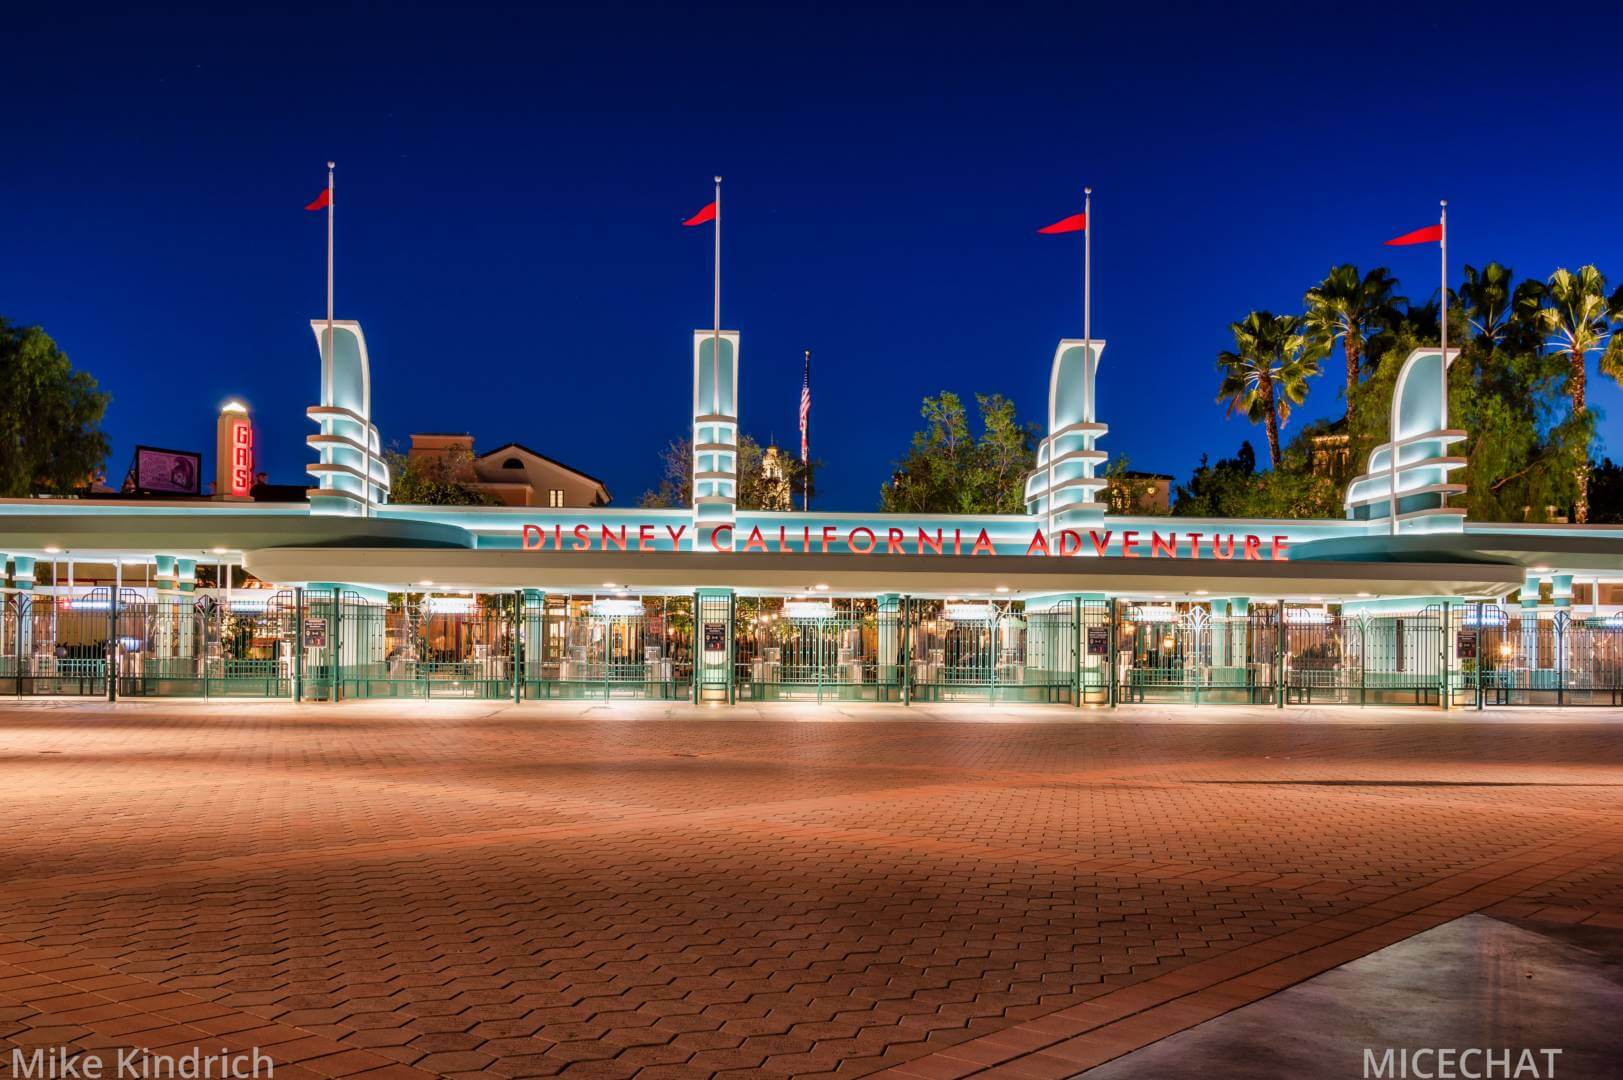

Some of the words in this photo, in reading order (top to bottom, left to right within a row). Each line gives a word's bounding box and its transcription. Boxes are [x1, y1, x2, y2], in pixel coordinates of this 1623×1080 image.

[235, 426, 247, 487] GAS
[521, 524, 687, 552] DISNEY
[710, 525, 997, 555] CALIFORNIA
[1026, 528, 1290, 561] ADVENTURE
